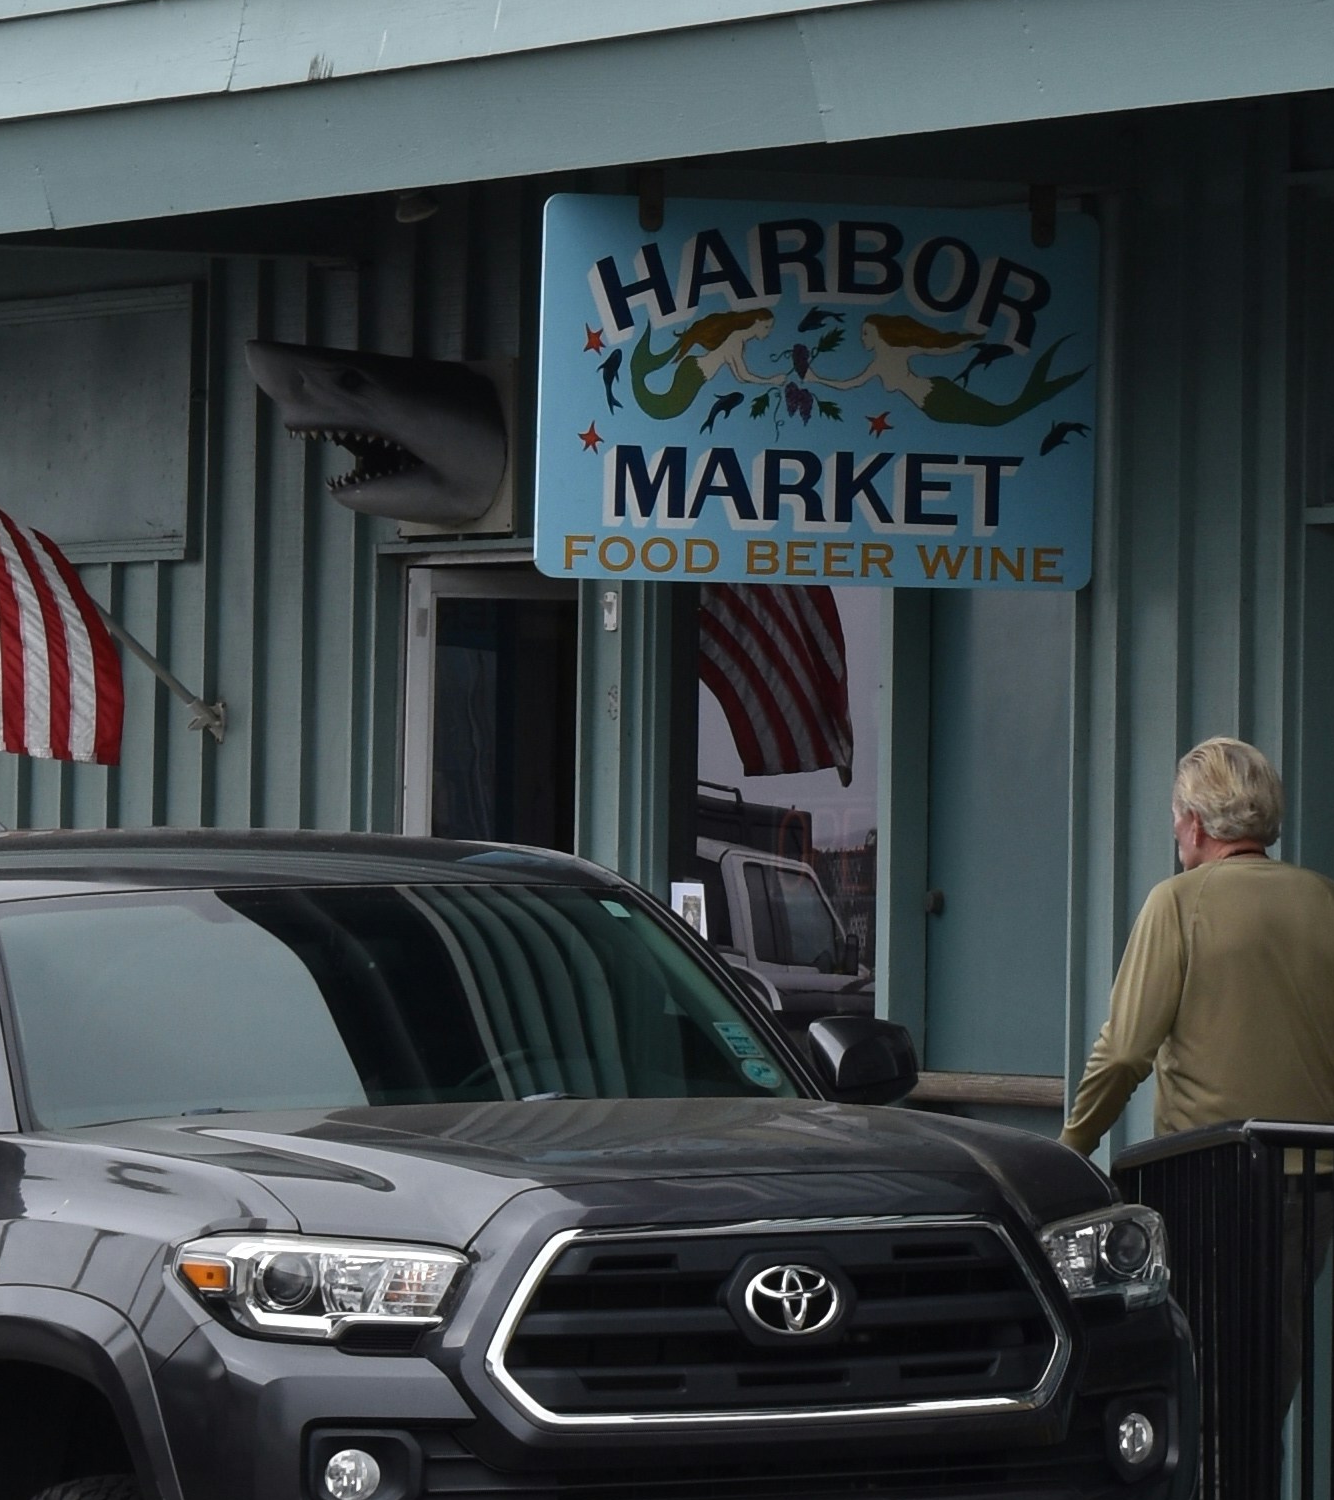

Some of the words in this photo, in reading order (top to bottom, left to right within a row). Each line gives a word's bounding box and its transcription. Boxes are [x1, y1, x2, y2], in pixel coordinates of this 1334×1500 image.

[588, 218, 1052, 352] HARBOR
[603, 445, 1024, 536] MARKET
[563, 535, 720, 574] FOOD
[745, 540, 894, 578] BEER
[916, 545, 1065, 584] WINE
